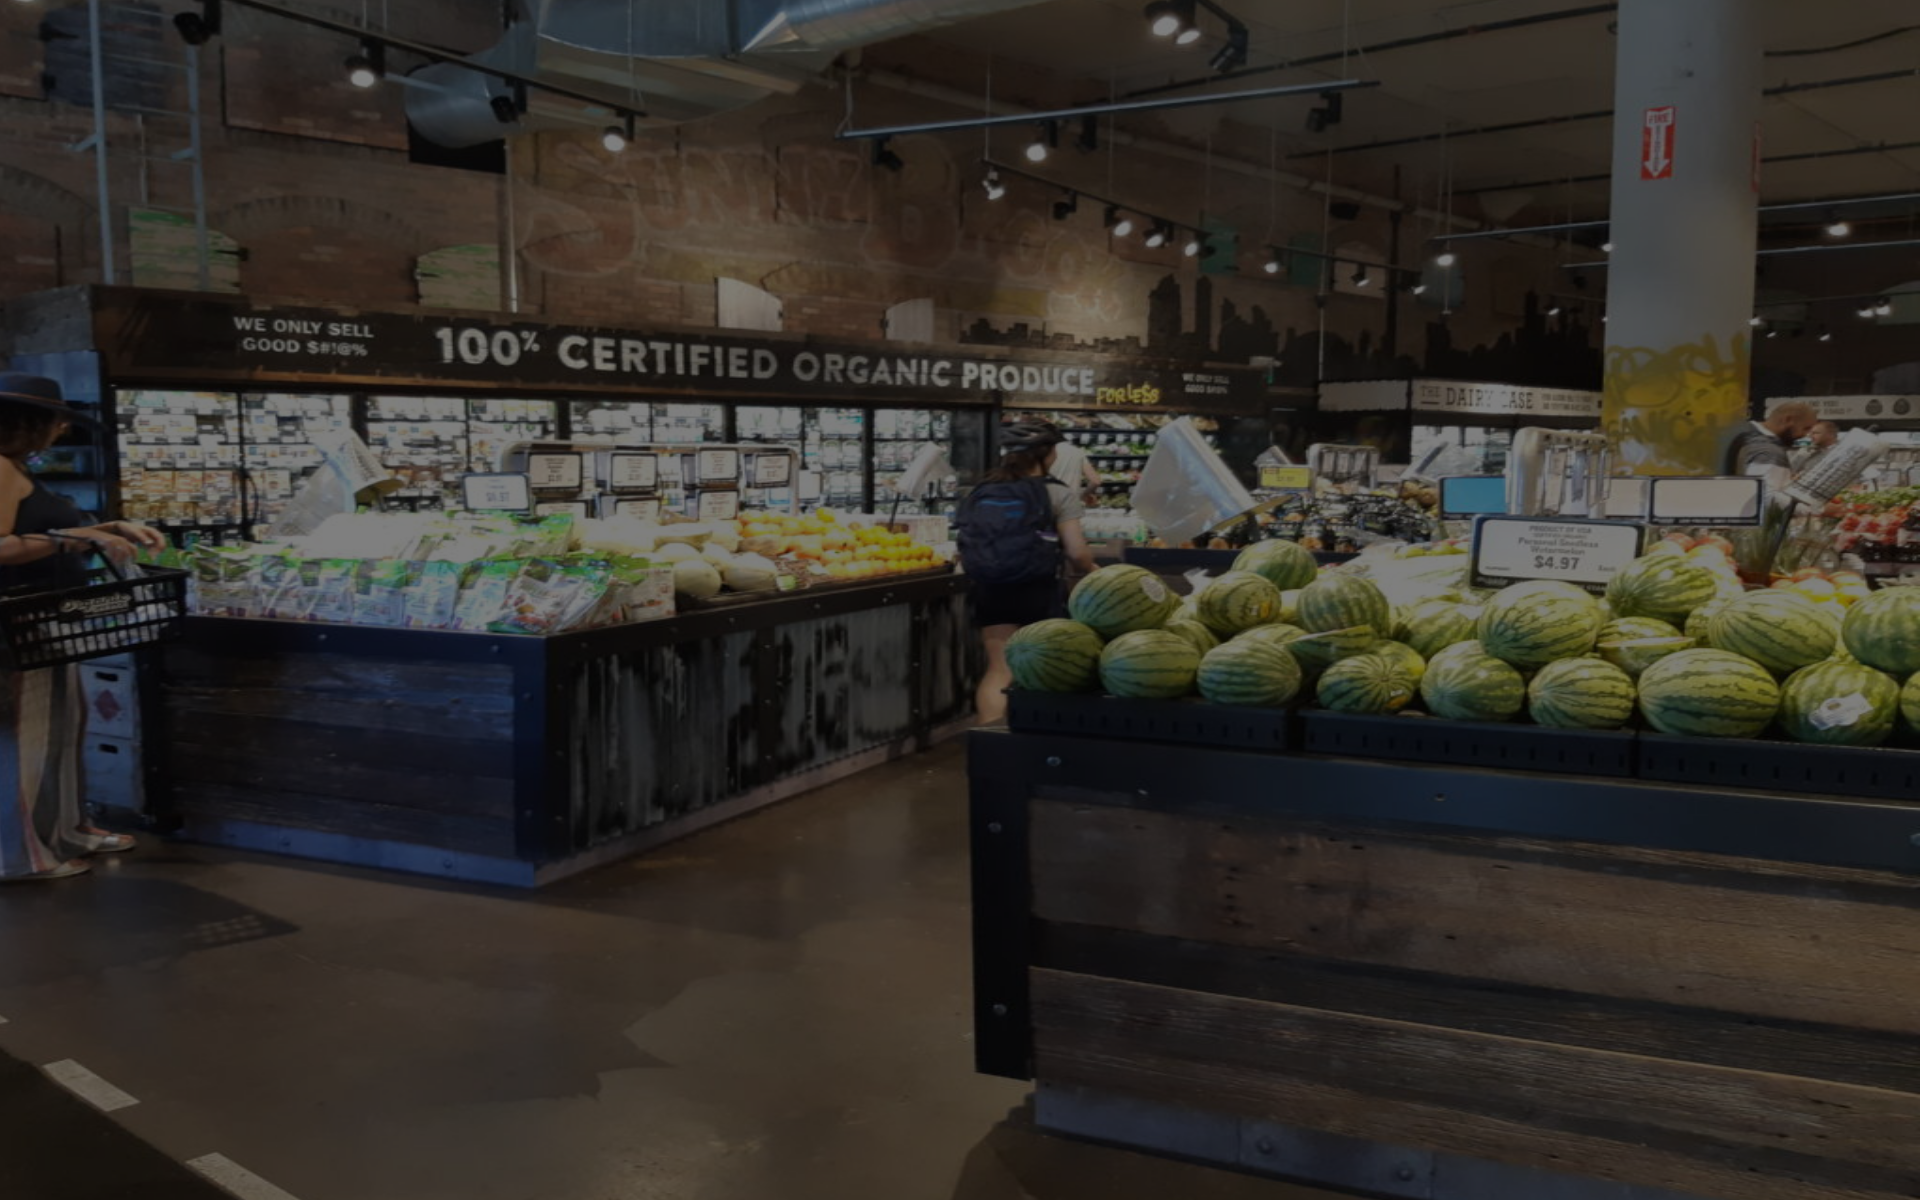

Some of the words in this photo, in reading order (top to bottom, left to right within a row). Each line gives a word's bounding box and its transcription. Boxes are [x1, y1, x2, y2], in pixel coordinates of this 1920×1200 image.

[233, 316, 267, 332] WE
[273, 319, 323, 335] ONLY
[327, 322, 375, 339] SELL
[242, 337, 301, 354] GOOD
[435, 326, 541, 366] 100%
[557, 334, 778, 380] CERTIFIED
[792, 351, 953, 388] ORGANIC
[961, 361, 1096, 395] PRODUCE
[1528, 525, 1565, 533] PRODUCT
[1534, 555, 1580, 570] $4.97
